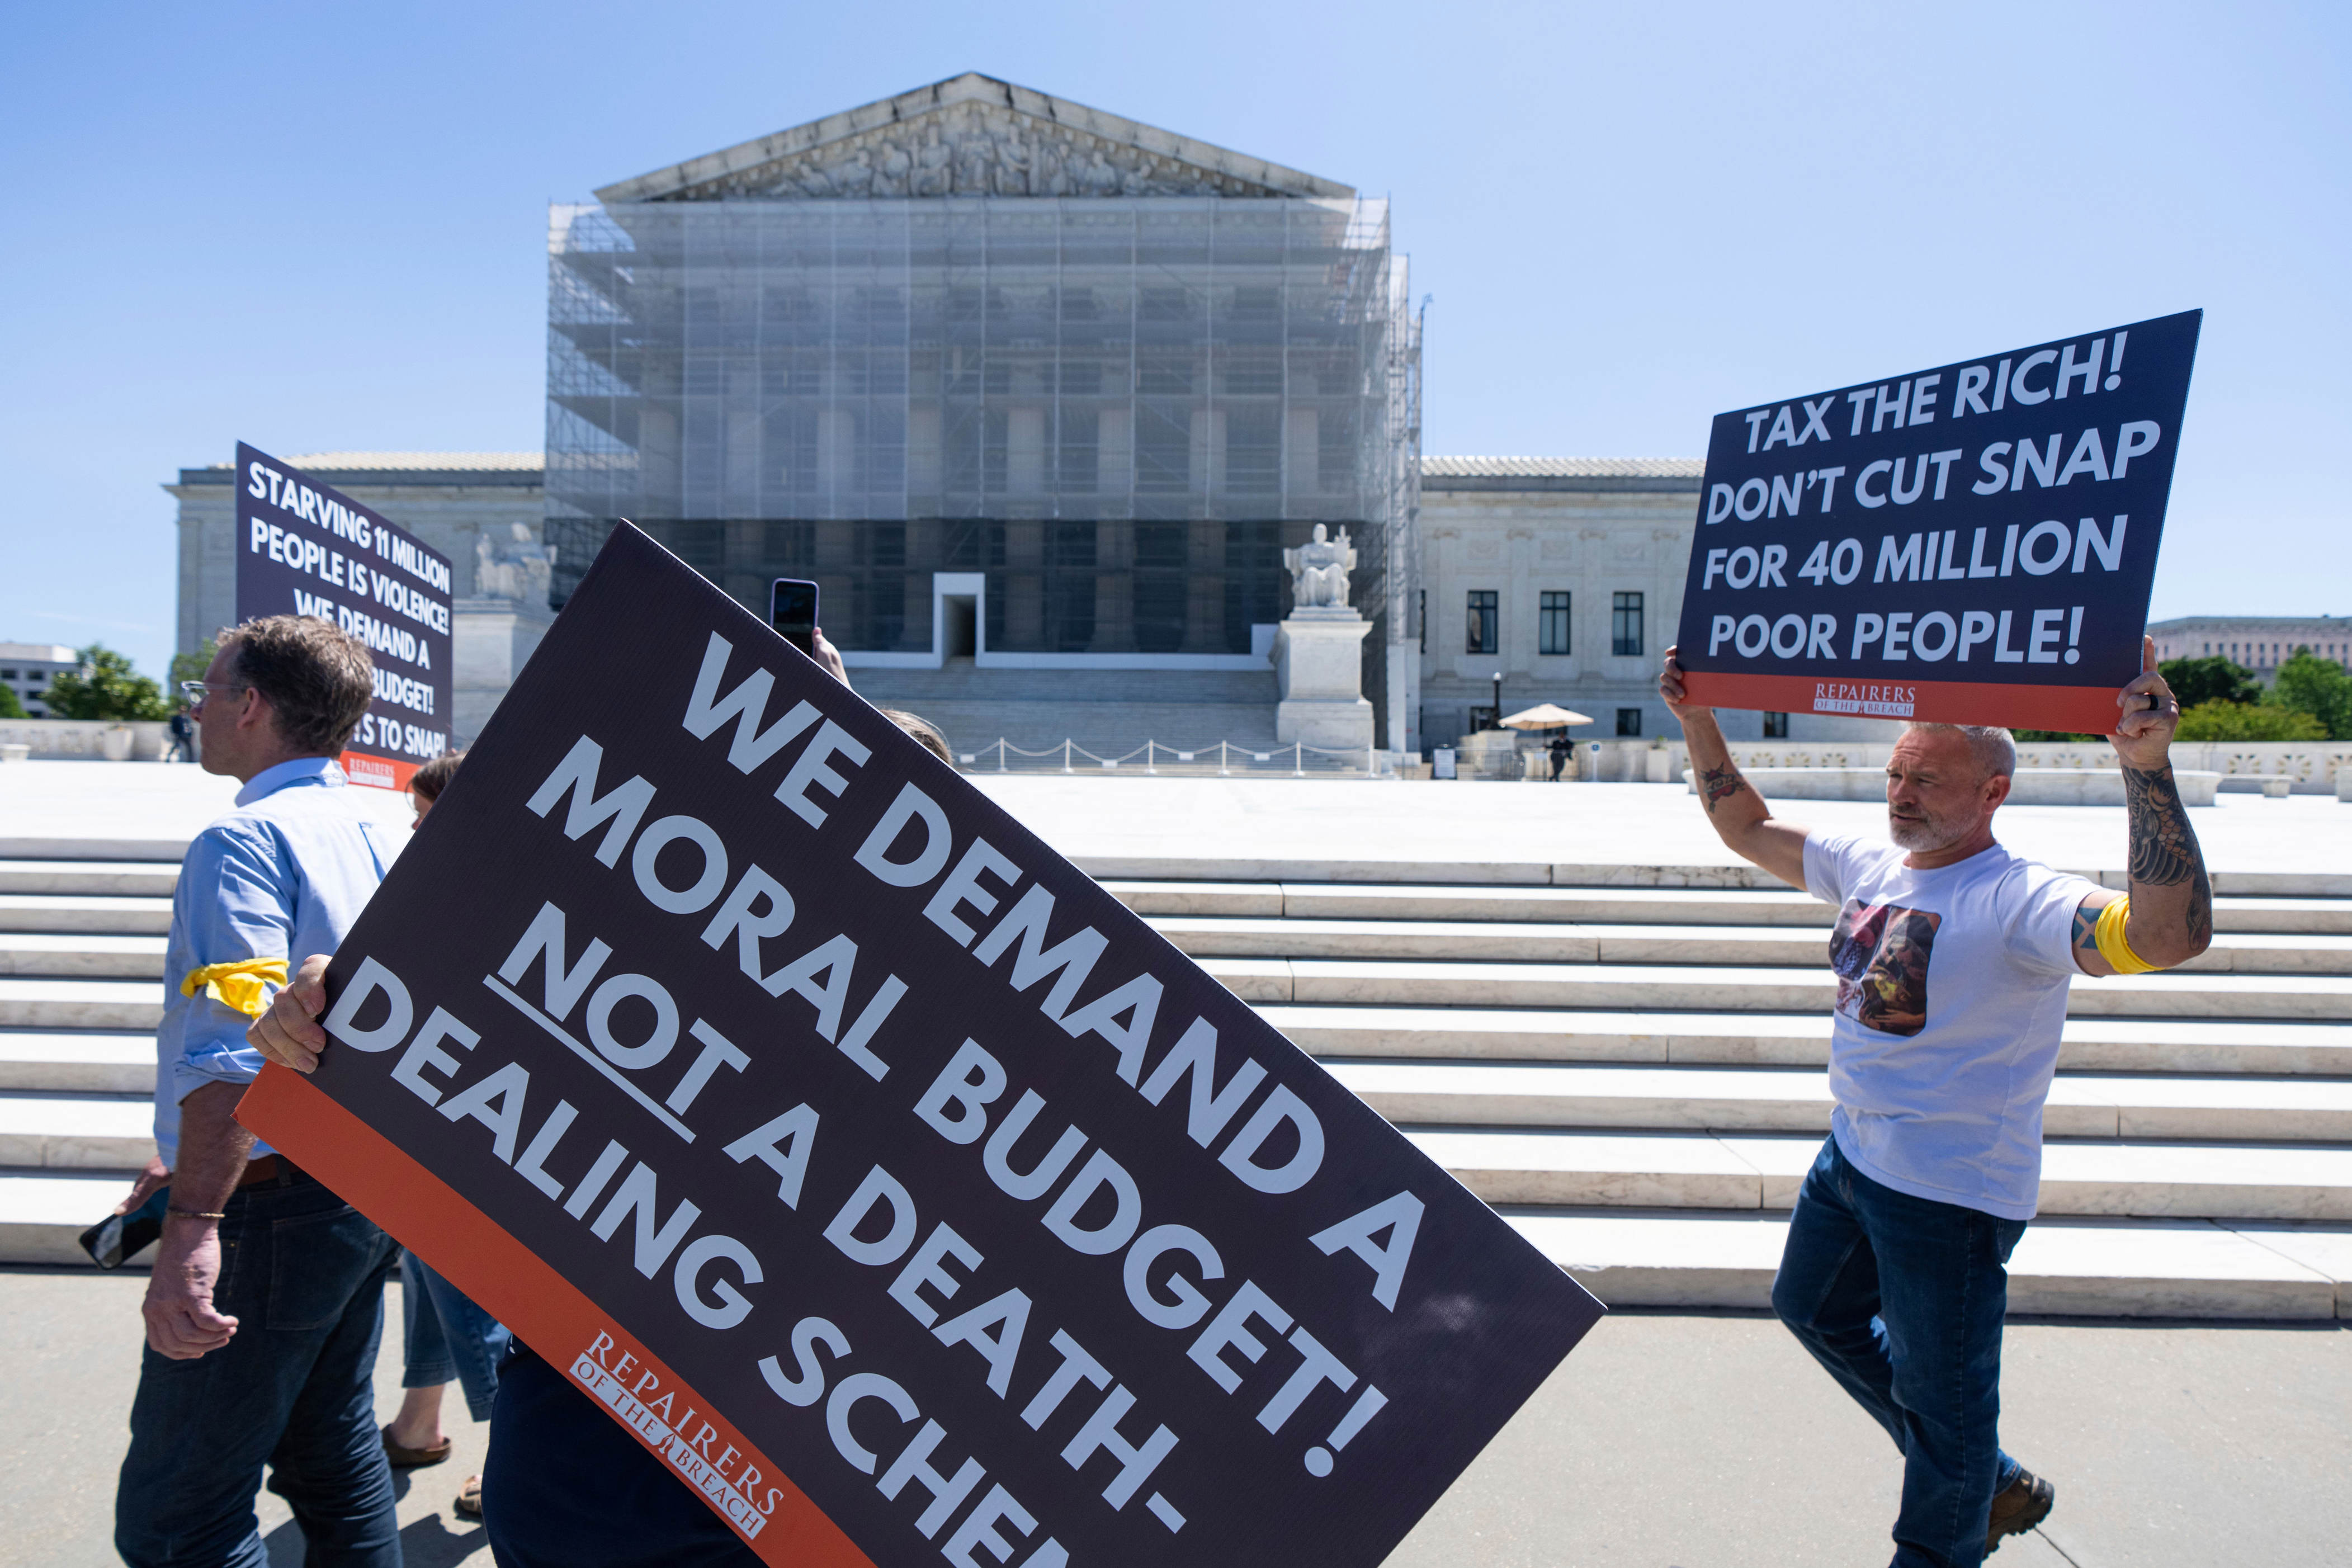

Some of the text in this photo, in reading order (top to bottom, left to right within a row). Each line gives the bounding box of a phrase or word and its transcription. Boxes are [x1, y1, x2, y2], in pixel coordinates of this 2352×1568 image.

[1745, 330, 2128, 454] TAX THE RICH!
[1855, 448, 1963, 508] CUT
[1971, 420, 2161, 495] SNAP
[248, 461, 450, 594] STARVING 11 MILLION
[251, 517, 450, 636] PEOPLE IS VIOLENCE!
[1703, 514, 2128, 590] FOR 40 MILLION
[294, 588, 431, 670] WE DEMAND A
[1709, 606, 2085, 665] POOR PEOPLE!
[377, 716, 403, 751] TO
[1816, 683, 1915, 703] REPAIRERS
[1816, 701, 1912, 715] OF THE BREACH
[350, 758, 395, 776] REPAIRERS
[682, 631, 1425, 1312] WE DEMAND A
[526, 734, 1388, 1477] MORAL BUDGET!
[323, 956, 1069, 1568] DEALING SCHE
[498, 901, 1187, 1534] NOT A DEATH-
[577, 1361, 761, 1533] OF THE BREACH
[585, 1328, 784, 1515] REPAIRERS
